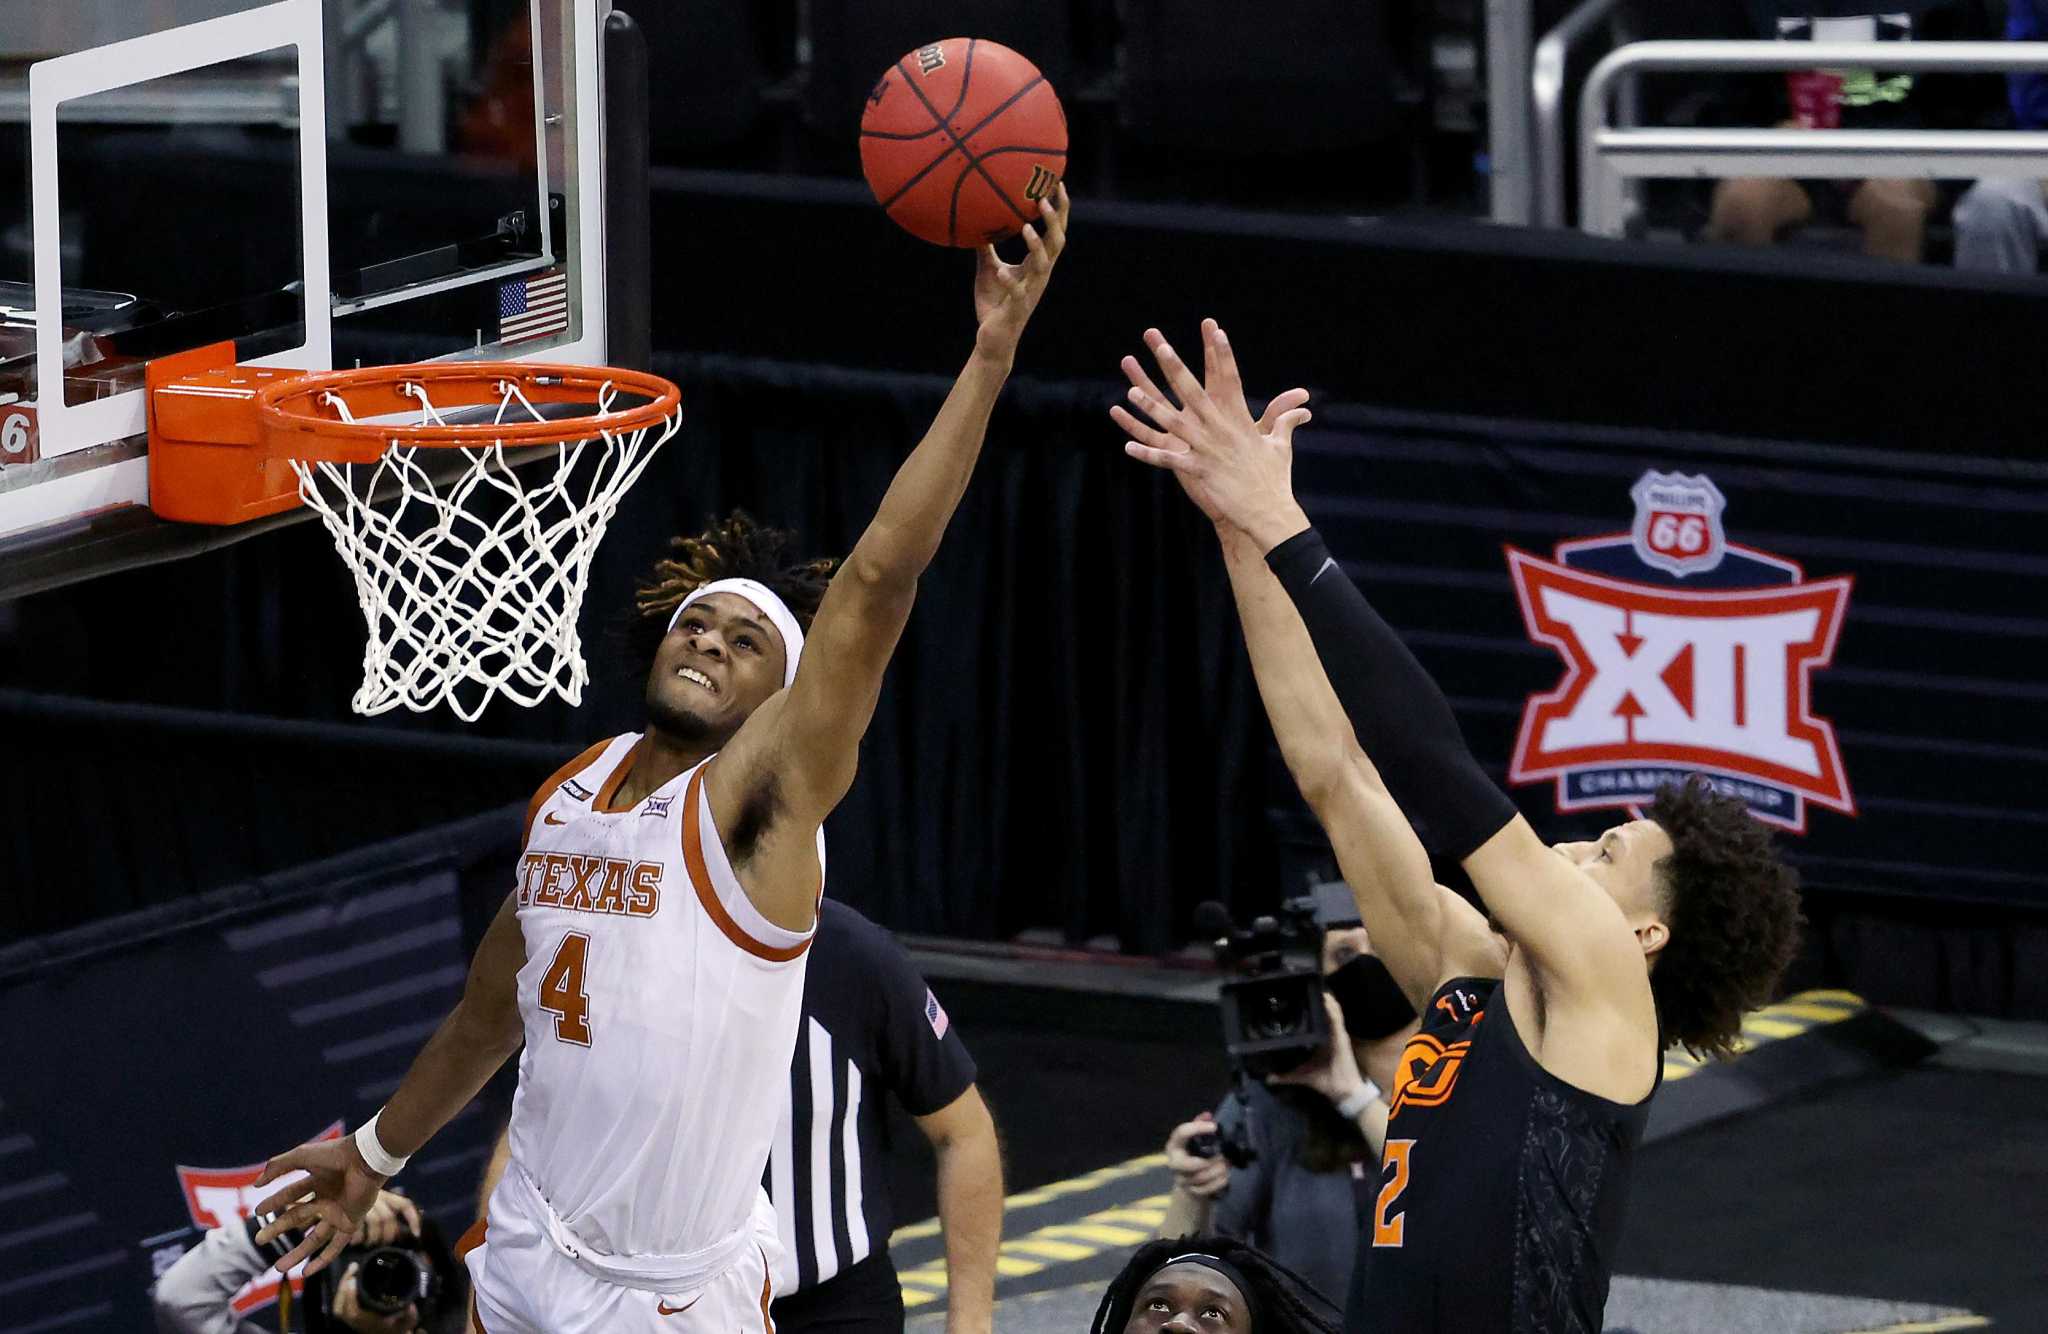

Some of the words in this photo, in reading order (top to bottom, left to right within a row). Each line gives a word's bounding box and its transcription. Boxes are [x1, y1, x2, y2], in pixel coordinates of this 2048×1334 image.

[1, 413, 31, 453] 6
[1652, 514, 1703, 551] 66
[1539, 584, 1823, 779] XII
[518, 851, 664, 919] TEXAS
[538, 930, 592, 1049] 4
[1372, 1138, 1418, 1248] 2
